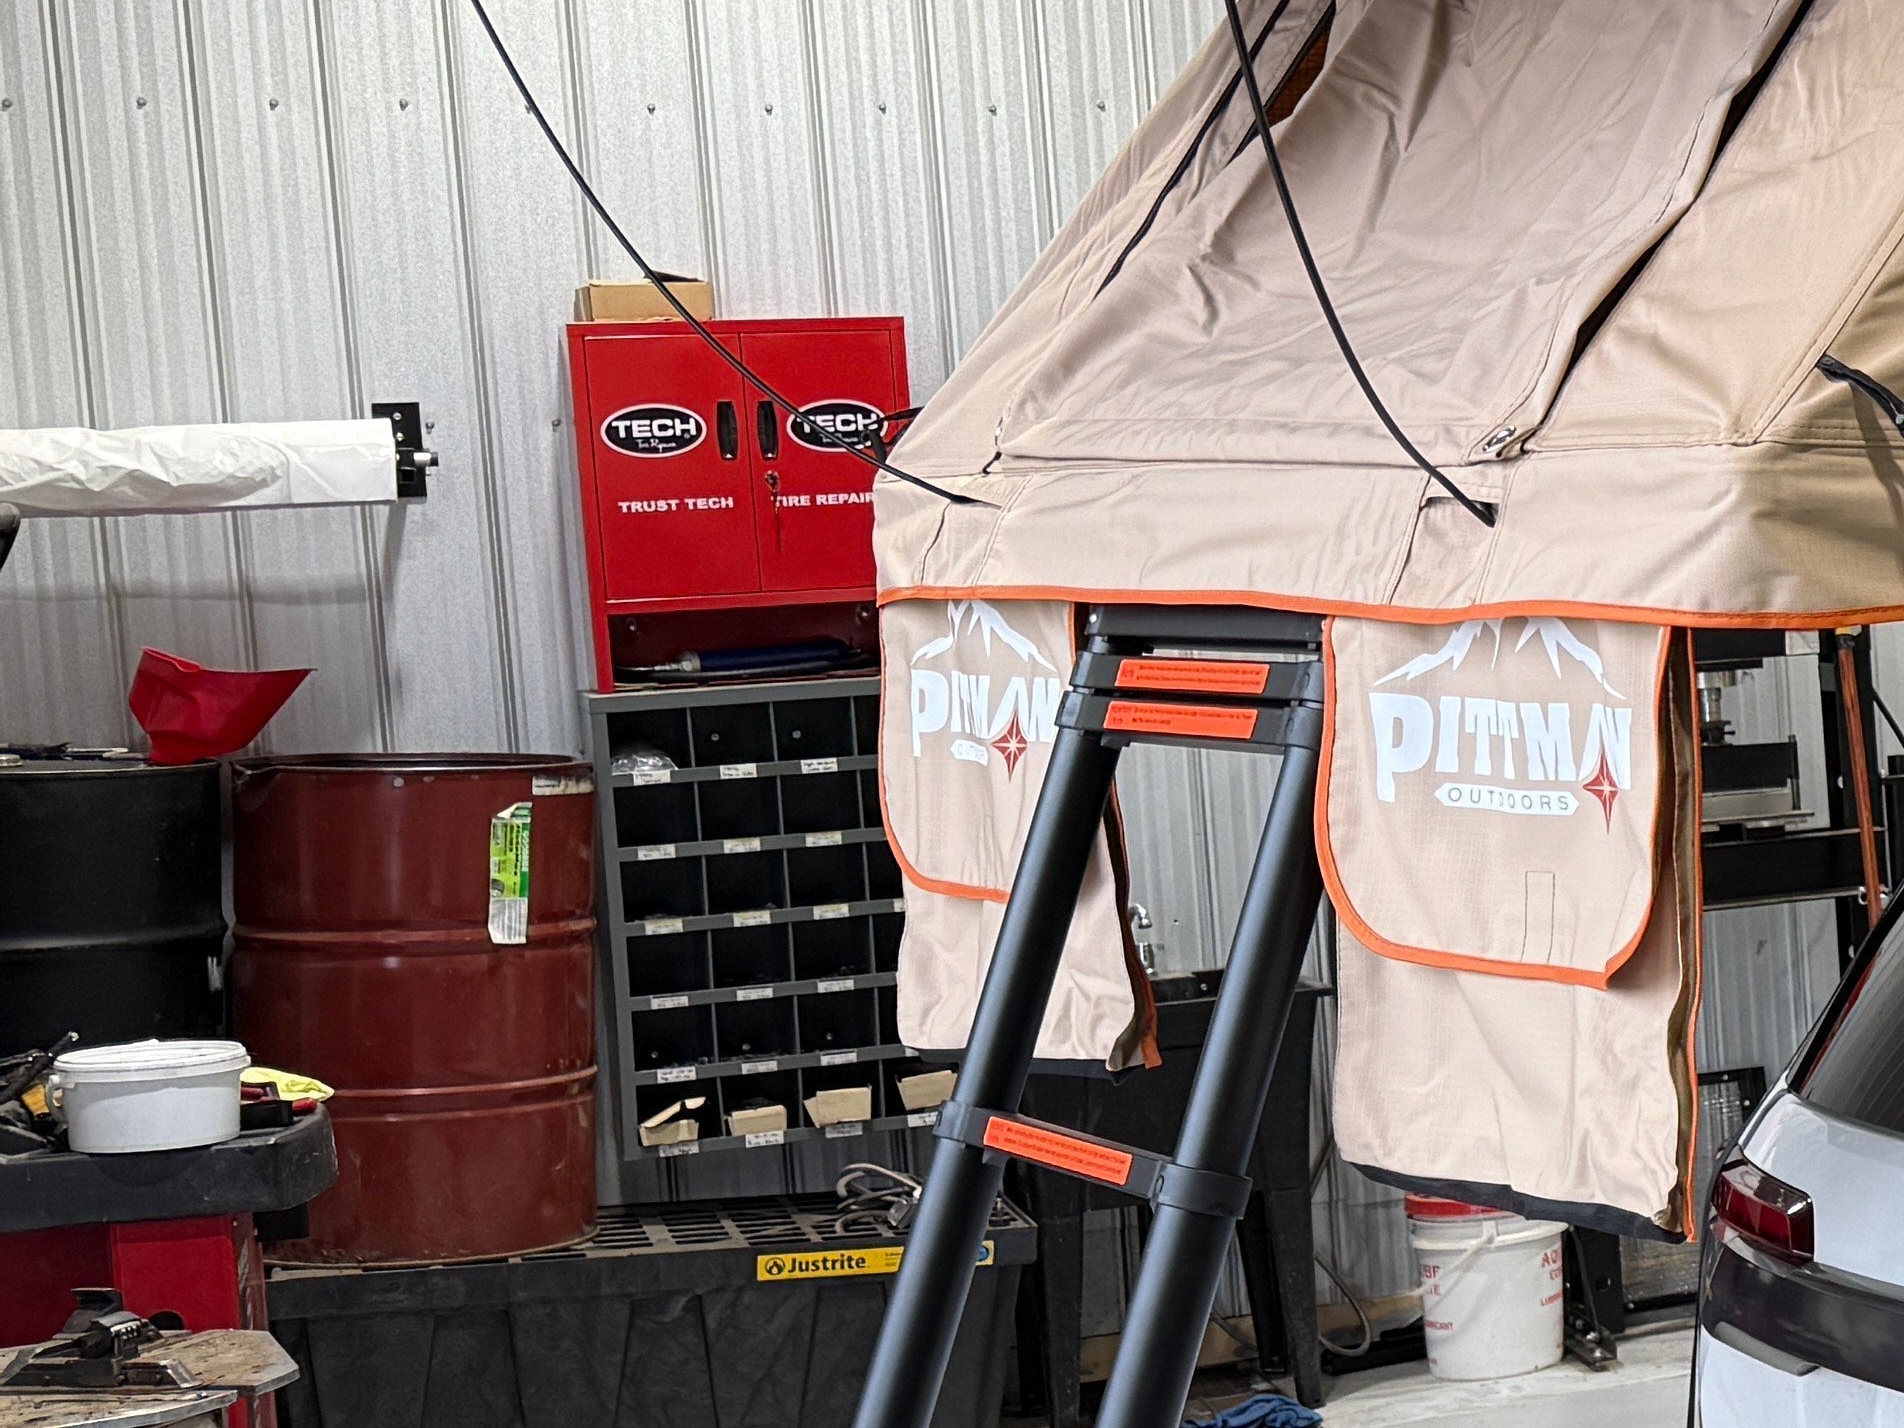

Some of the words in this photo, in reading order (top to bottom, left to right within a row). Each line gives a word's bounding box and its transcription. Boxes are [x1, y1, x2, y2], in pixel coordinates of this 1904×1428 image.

[611, 418, 697, 439] TECH
[795, 413, 878, 434] TECH
[618, 499, 679, 513] TRUST
[684, 496, 734, 511] TECH
[771, 494, 811, 508] TIRE
[1369, 692, 1632, 803] PITTMAN
[787, 1253, 867, 1274] Justrite
